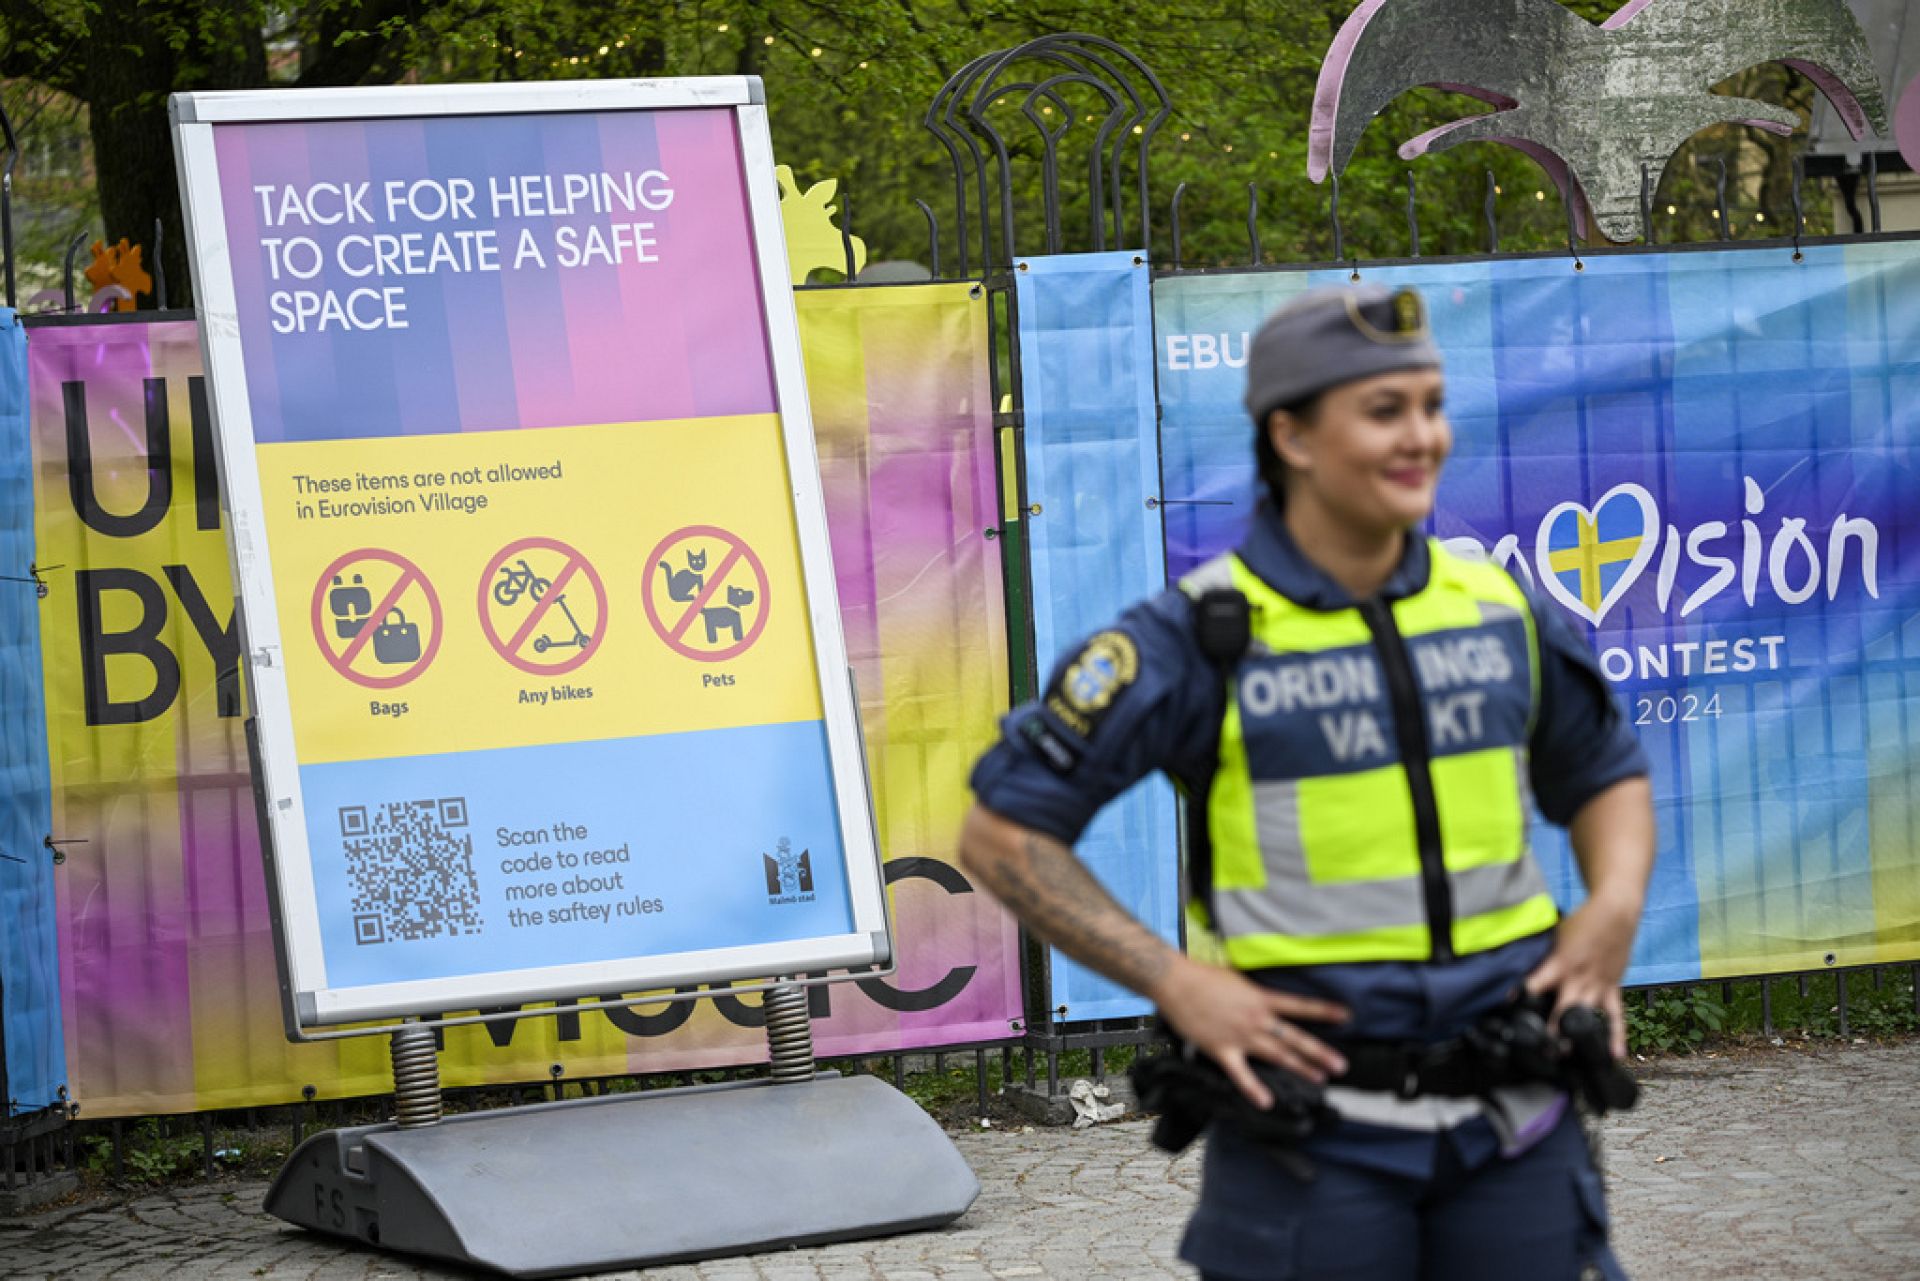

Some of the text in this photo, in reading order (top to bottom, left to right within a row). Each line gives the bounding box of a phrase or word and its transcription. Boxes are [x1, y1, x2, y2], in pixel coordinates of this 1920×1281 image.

[254, 170, 675, 227] TACK FOR HELPING
[260, 222, 659, 280] TO CREATE A SAFE
[270, 286, 409, 334] SPACE
[1166, 331, 1250, 371] EBU
[292, 460, 562, 494] These items are not allowed
[296, 492, 488, 519] in Eurovision Village
[75, 564, 243, 727] BY
[1600, 636, 1785, 682] ONTEST
[518, 685, 593, 705] Any bikes
[703, 673, 735, 688] Pets
[369, 700, 409, 718] Bags
[1635, 693, 1723, 725] 2024
[496, 822, 588, 847] Scan the
[500, 843, 630, 874] code to read
[506, 872, 624, 901] more about
[508, 895, 664, 927] the saftey rules
